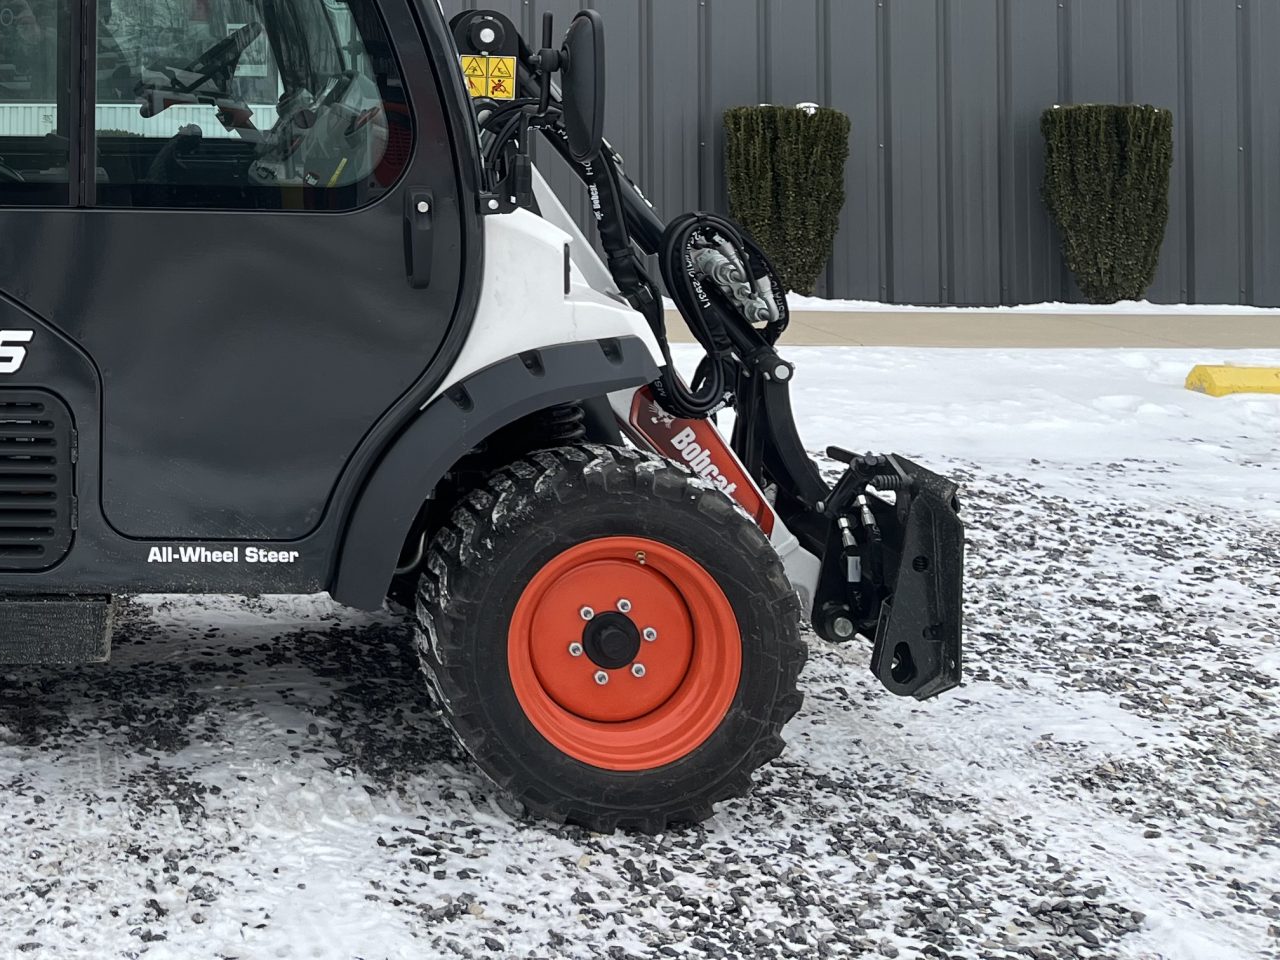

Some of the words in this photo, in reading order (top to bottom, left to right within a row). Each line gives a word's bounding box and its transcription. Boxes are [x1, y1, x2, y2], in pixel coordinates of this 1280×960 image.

[671, 426, 738, 497] Bobcat
[147, 546, 239, 563] All-Wheel
[244, 546, 299, 563] Steer
